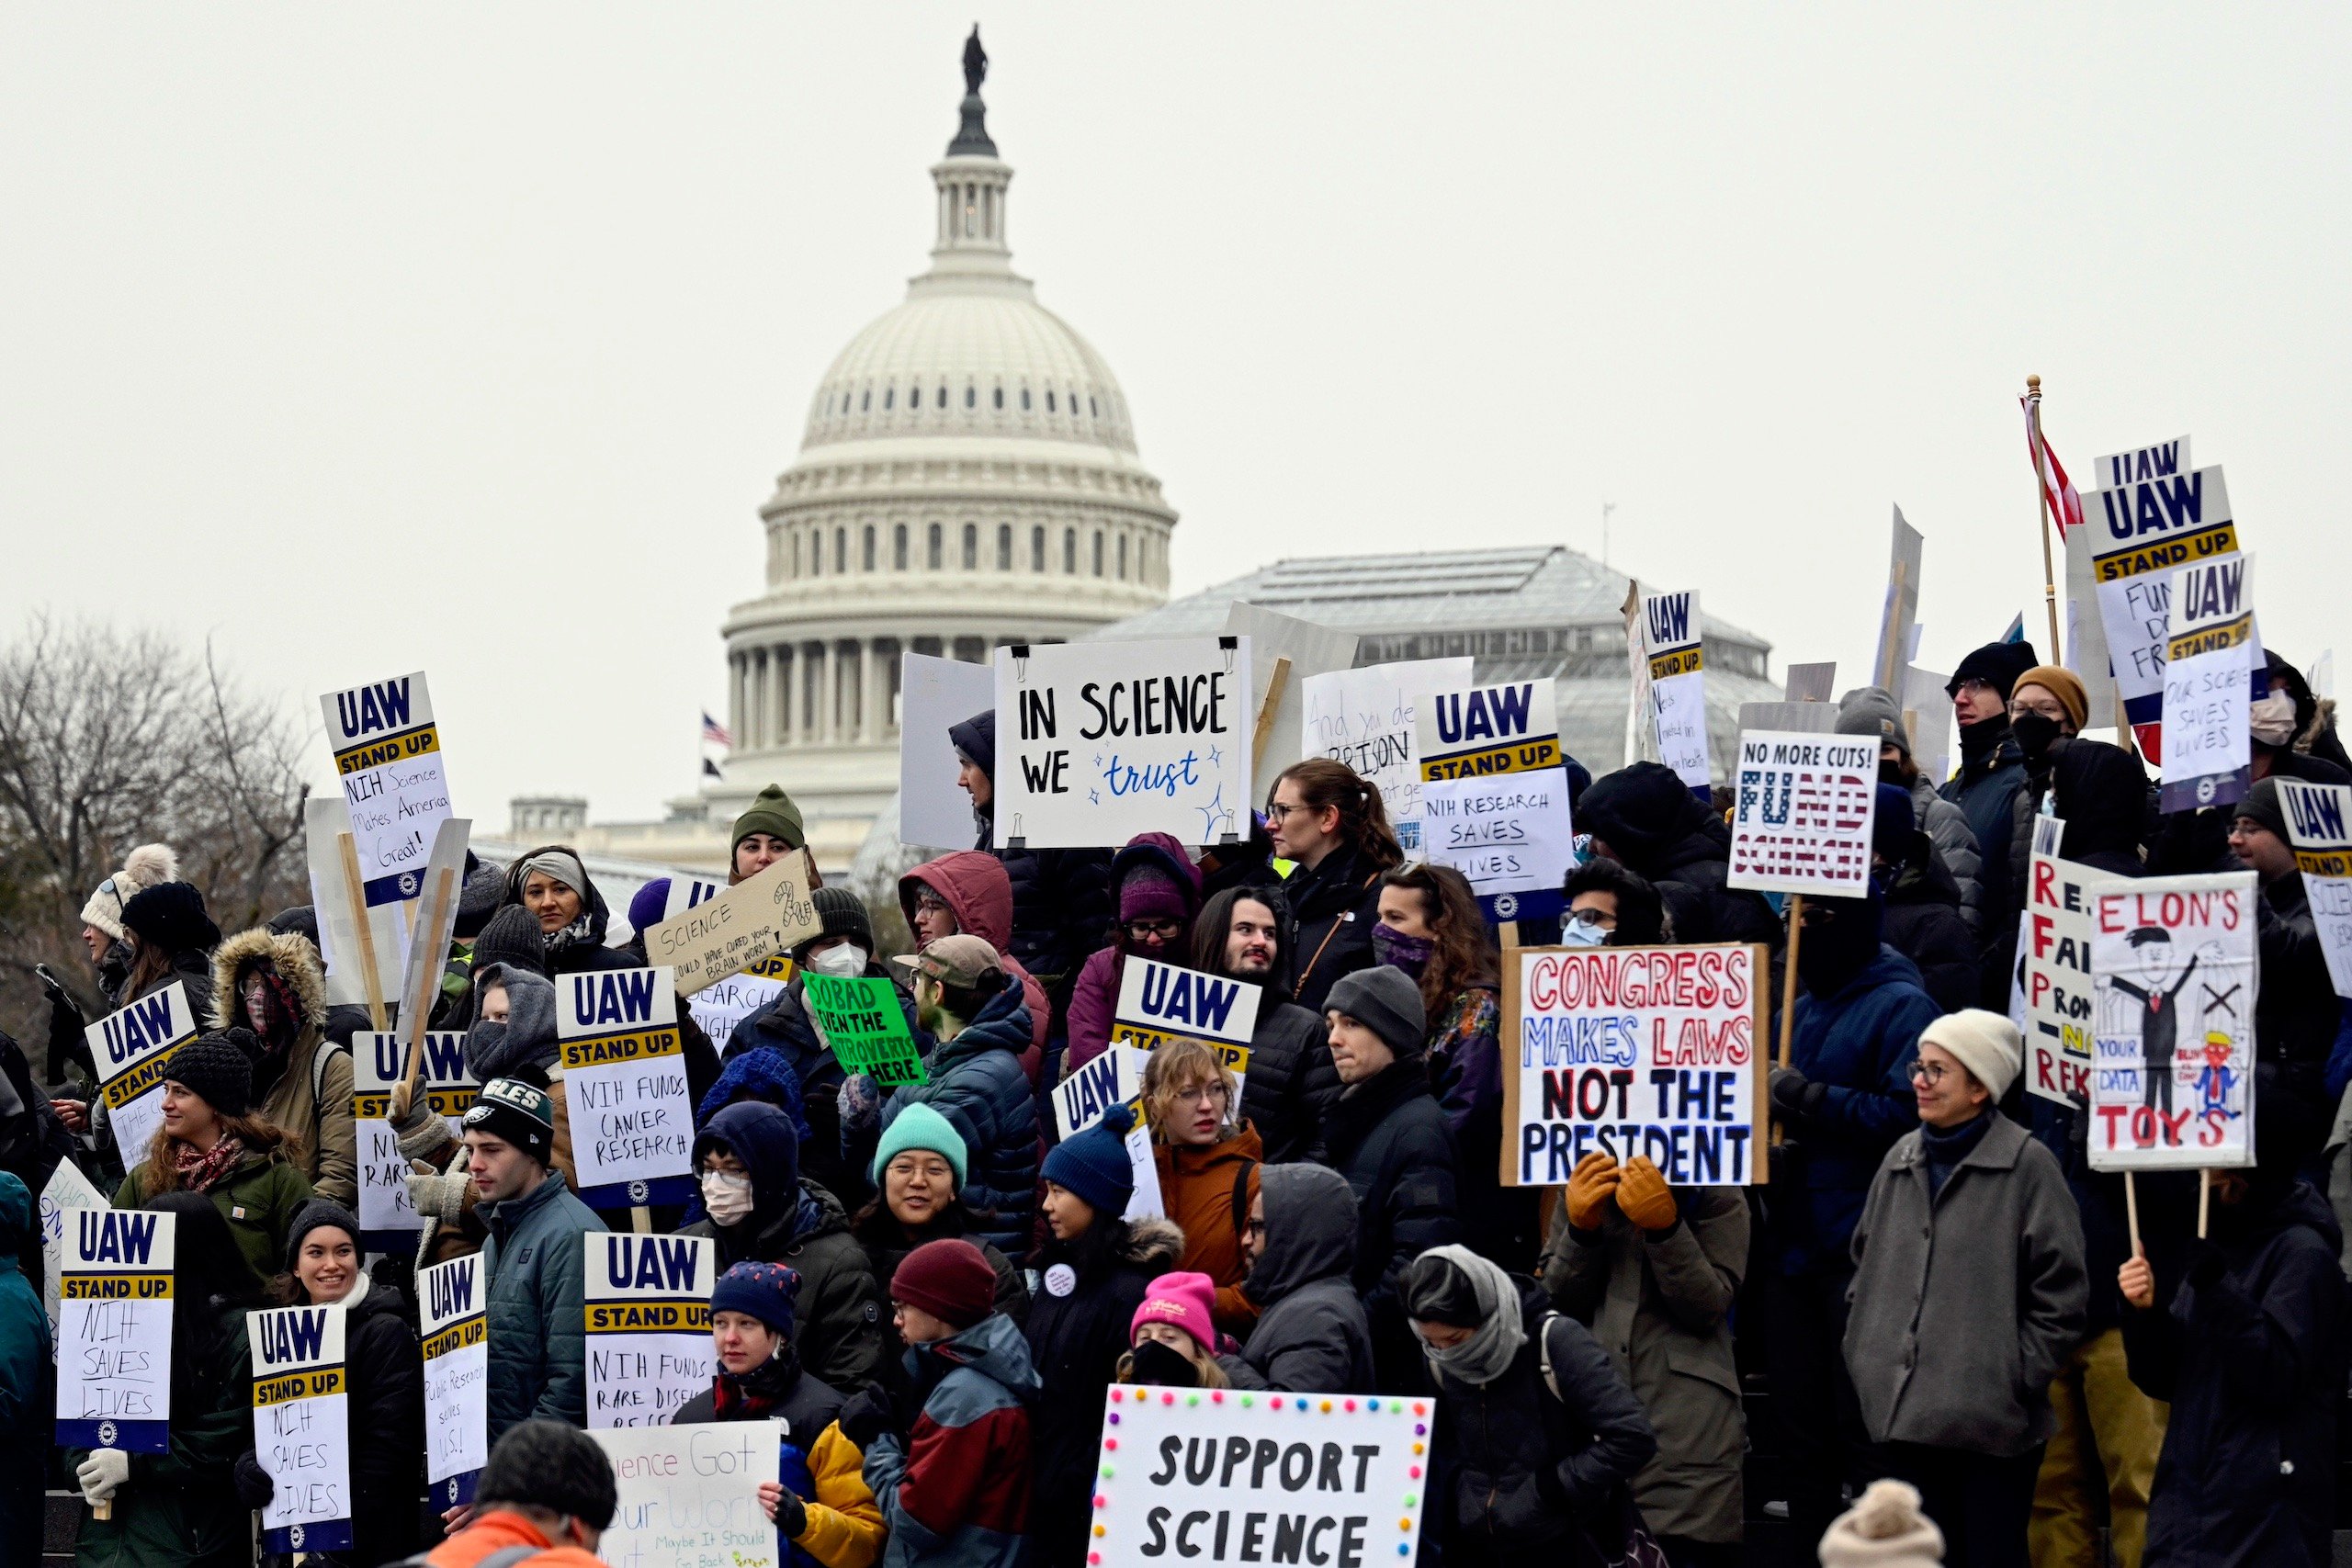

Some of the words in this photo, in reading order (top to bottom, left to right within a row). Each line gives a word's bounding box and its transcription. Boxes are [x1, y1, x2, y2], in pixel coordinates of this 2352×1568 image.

[2102, 471, 2201, 540] UAW
[2102, 544, 2188, 581] STAND
[2195, 532, 2230, 556] UP
[2125, 582, 2172, 620] FUN
[2185, 558, 2245, 622] UAW
[1647, 592, 1690, 643] UAW
[2172, 631, 2230, 660] STAND
[1652, 657, 1680, 680] STAND
[1684, 652, 1699, 671] UP
[337, 677, 410, 739] UAW
[1020, 688, 1056, 740] IN
[1080, 671, 1227, 739] SCIENCE
[1306, 689, 1349, 740] And
[1393, 688, 1414, 726] de
[1436, 683, 1532, 744] UAW
[2177, 699, 2231, 731] SAVES
[341, 742, 400, 773] STAND
[406, 733, 433, 753] UP
[1329, 731, 1408, 775] PRISON
[1745, 744, 1768, 763] NO
[1773, 744, 1820, 766] MORE
[1827, 747, 1872, 768] CUTS!
[2176, 727, 2230, 758] LIVES
[1021, 750, 1069, 794] WE
[1103, 750, 1199, 796] trust
[1428, 753, 1510, 781] STAND
[1521, 745, 1553, 765] UP
[345, 771, 384, 806] NIH
[388, 766, 437, 791] Science
[1738, 771, 1868, 834] FUND
[398, 796, 448, 821] America
[1427, 798, 1454, 817] NIH
[1464, 794, 1549, 816] RESEARCH
[2284, 785, 2346, 840] UAW
[377, 831, 424, 867] Great!
[1451, 819, 1525, 843] SAVES
[1454, 855, 1521, 874] LIVES
[1735, 834, 1865, 881] SCIENCE!
[661, 904, 731, 955] SCIENCE
[2099, 889, 2239, 934] ELON'S
[704, 947, 723, 964] HAVE
[726, 935, 749, 953] CURED
[751, 925, 772, 941] YOUR
[706, 955, 739, 979] BRAIN
[743, 941, 768, 962] WORM
[2032, 913, 2090, 974] FAI
[751, 959, 784, 976] UP
[1531, 951, 1747, 1010] CONGRESS
[574, 971, 655, 1025] UAW
[1140, 964, 1239, 1032] UAW
[102, 990, 174, 1065] UAW
[818, 1009, 849, 1033] EVEN
[849, 1011, 887, 1033] THE
[568, 1039, 639, 1064] STAND
[645, 1033, 674, 1054] UP
[1120, 1029, 1172, 1052] STA
[1522, 1015, 1638, 1067] MAKES
[1653, 1015, 1751, 1066] LAWS
[2097, 1039, 2137, 1057] YOUR
[108, 1059, 166, 1103] STAND
[866, 1059, 919, 1083] HERE
[2036, 1048, 2090, 1100] RFK
[2099, 1068, 2139, 1091] DATA
[362, 1097, 445, 1116] STD
[482, 1079, 541, 1110] GLES
[580, 1081, 623, 1111] NIH
[638, 1075, 684, 1100] FUNDS
[1064, 1049, 1119, 1131] UAW
[1543, 1068, 1634, 1121] NOT
[1650, 1069, 1736, 1122] THE
[116, 1105, 147, 1137] THE
[602, 1109, 670, 1138] CANCER
[2097, 1104, 2226, 1150] TOYS
[373, 1133, 397, 1162] NI
[596, 1134, 686, 1167] RESEARCH
[1522, 1122, 1751, 1183] PRESIDENT
[80, 1212, 157, 1265] UAW
[608, 1237, 698, 1292] UAW
[66, 1280, 130, 1298] STAND
[139, 1280, 167, 1297] UP
[430, 1258, 474, 1321] UAW
[81, 1301, 140, 1342] NIH
[593, 1307, 678, 1327] STAND
[685, 1307, 711, 1325] UP
[259, 1308, 327, 1364] UAW
[426, 1330, 459, 1359] STAND
[465, 1323, 483, 1345] UP
[83, 1348, 150, 1377] SAVES
[594, 1351, 647, 1382] NIH
[660, 1354, 706, 1378] FUNDS
[79, 1386, 153, 1418] LIVES
[258, 1378, 306, 1404] STAND
[311, 1373, 339, 1393] UP
[424, 1380, 447, 1402] Public
[450, 1365, 484, 1391] Research
[597, 1389, 644, 1410] RARE
[274, 1403, 312, 1438] NIH
[439, 1404, 460, 1425] serves
[273, 1443, 327, 1473] SAVES
[616, 1453, 678, 1478] ience
[690, 1431, 756, 1477] Got
[1148, 1435, 1380, 1493] SUPPORT
[275, 1483, 339, 1517] LIVES
[607, 1499, 658, 1529] our
[655, 1535, 695, 1555] Maybe
[703, 1532, 716, 1545] It
[722, 1530, 765, 1547] Should
[1139, 1506, 1367, 1568] SCIENCE
